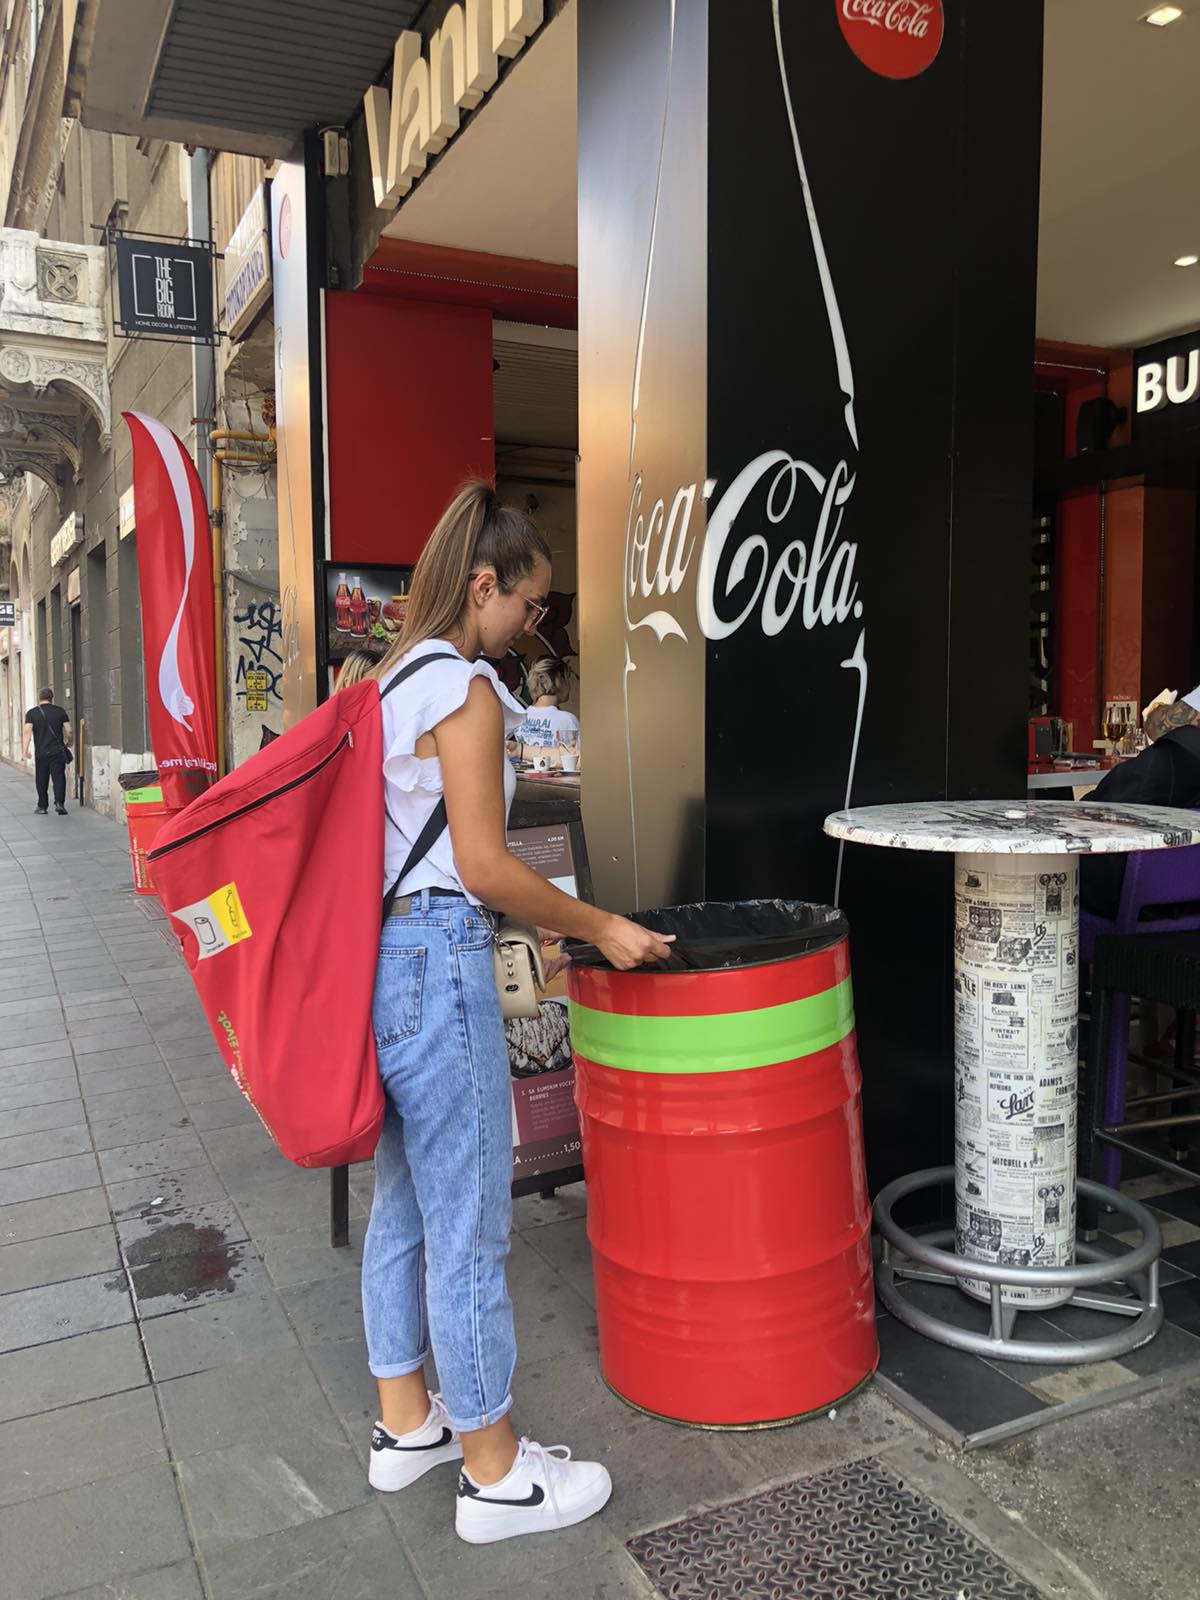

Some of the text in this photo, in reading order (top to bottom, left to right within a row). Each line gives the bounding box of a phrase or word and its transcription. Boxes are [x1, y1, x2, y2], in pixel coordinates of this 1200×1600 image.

[154, 256, 172, 279] THE
[155, 278, 174, 304] BIG
[156, 303, 175, 319] ROOM
[1136, 348, 1199, 413] BU
[563, 1140, 581, 1153] 1,50
